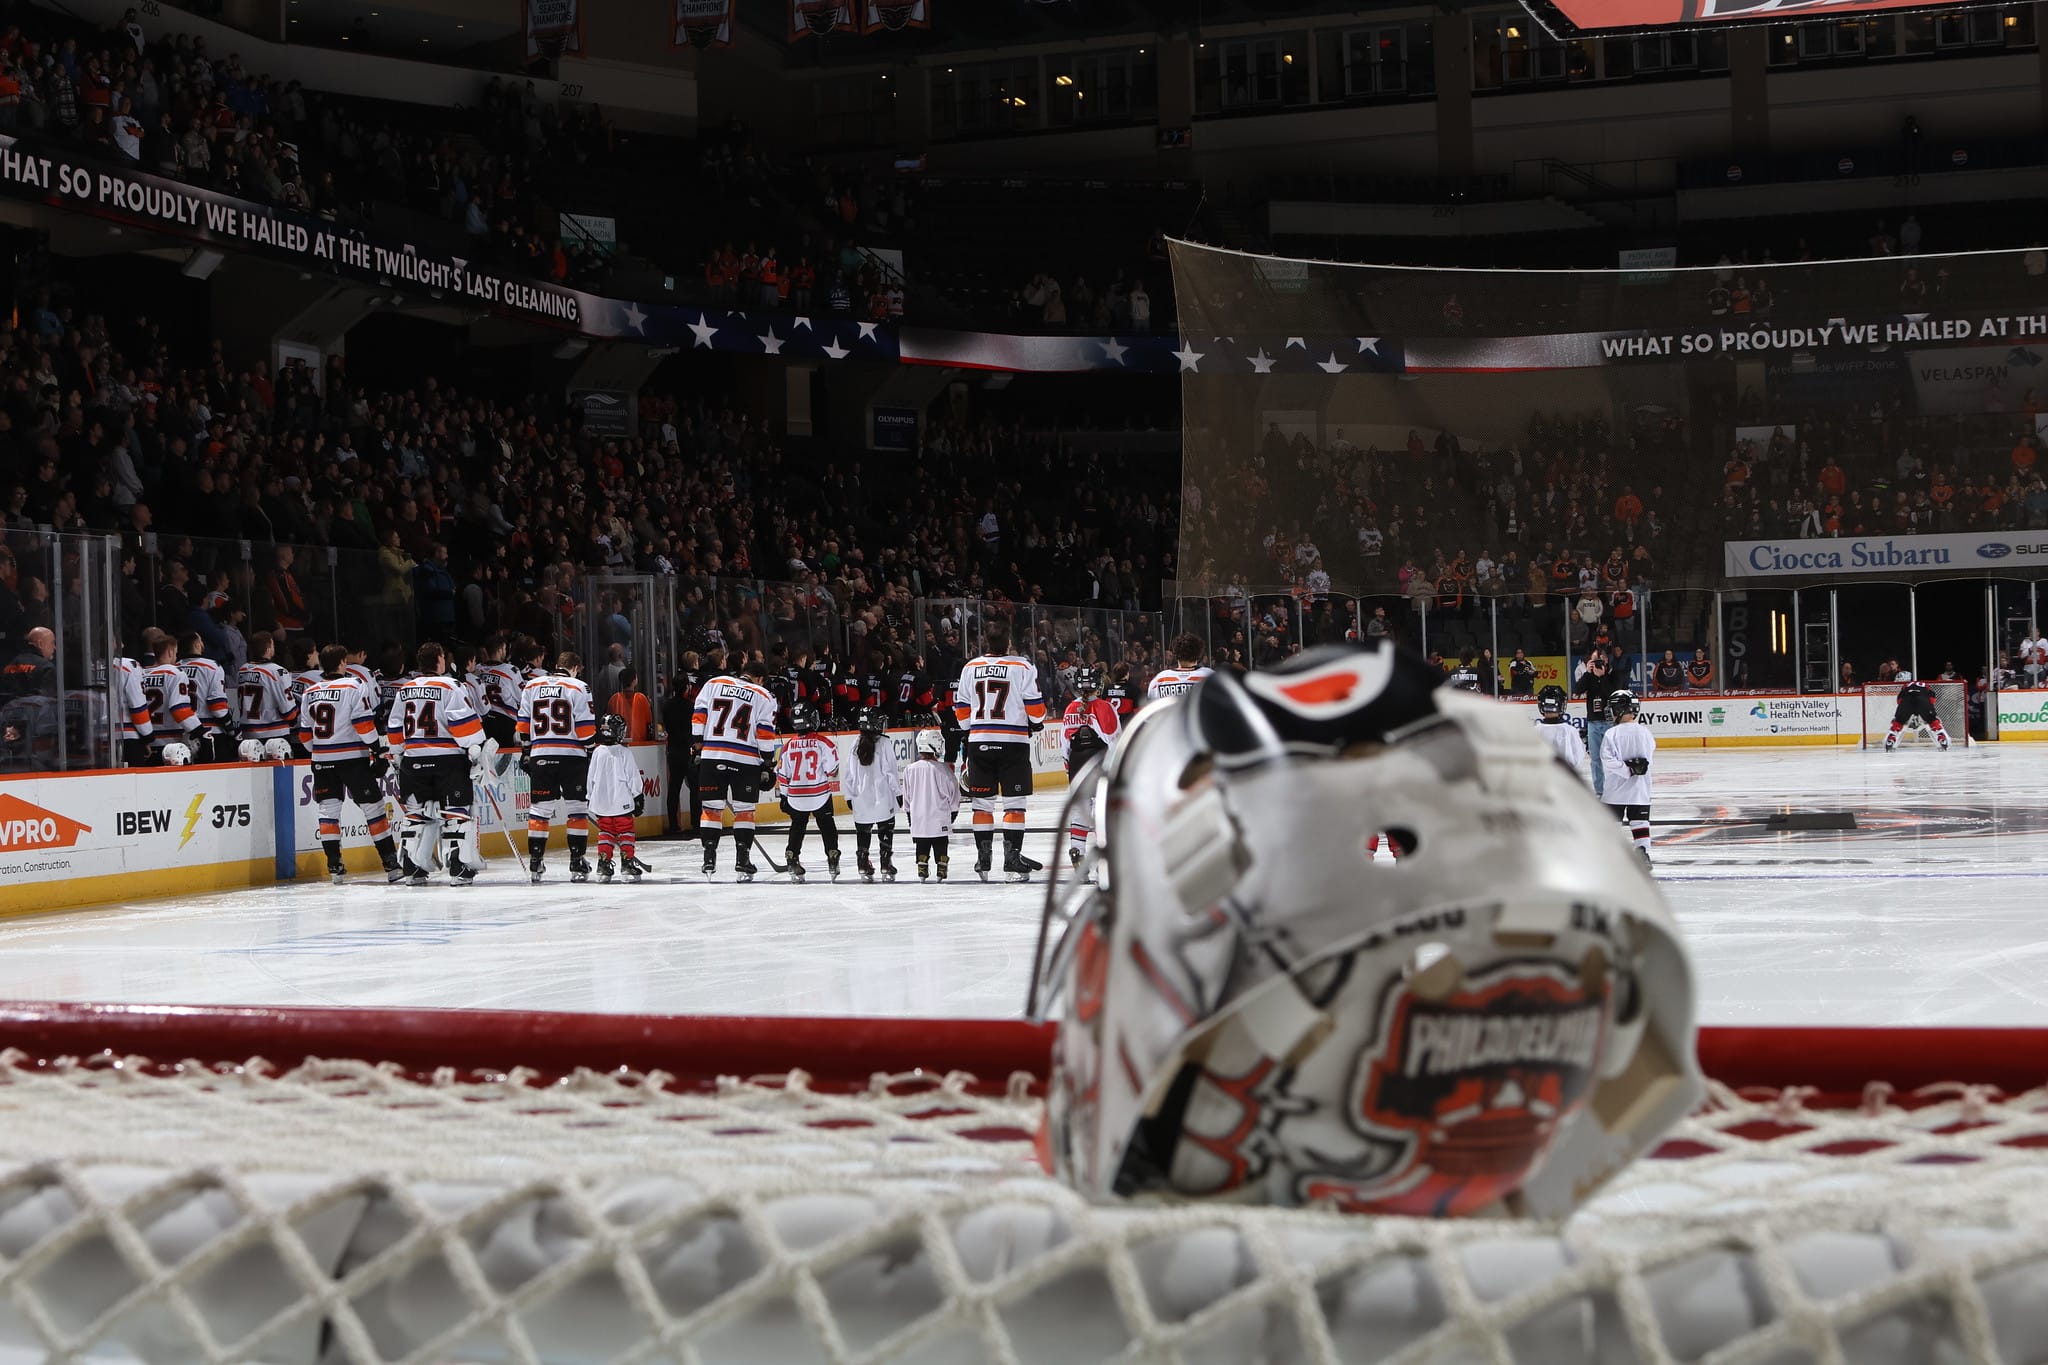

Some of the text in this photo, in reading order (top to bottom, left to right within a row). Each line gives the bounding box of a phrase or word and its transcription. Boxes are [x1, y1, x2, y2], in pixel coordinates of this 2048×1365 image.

[538, 3, 566, 14] SEASON
[682, 2, 723, 14] CHAMPIONS
[533, 11, 572, 26] CHAMPIONS
[561, 84, 583, 97] 207
[1894, 174, 1920, 188] 210
[1432, 206, 1455, 218] 209
[0, 149, 51, 189] HAT
[58, 163, 91, 199] SO
[99, 174, 200, 225] PROUDLY
[205, 202, 237, 236] WE
[243, 212, 308, 252] HAILED
[313, 231, 336, 260] AT
[340, 237, 370, 269] THE
[374, 247, 462, 292] TWILIGHT'S
[466, 271, 500, 302] LAST
[1601, 335, 1673, 358] WHAT
[1680, 333, 1714, 354] SO
[1721, 326, 1834, 351] PROUDLY
[1840, 324, 1879, 345] WE
[1886, 318, 1972, 343] HAILED
[1979, 316, 2009, 338] AT
[1921, 366, 2008, 383] VELASPAN
[878, 415, 914, 425] OLYMPUS
[1749, 541, 1951, 571] Ciocca Subaru
[975, 666, 1007, 679] WILSON
[401, 687, 441, 701] BJARNASON
[541, 687, 560, 697] BONK
[721, 686, 753, 702] WISDOM
[975, 681, 1011, 720] 17
[1770, 700, 1830, 712] Lehigh Valley
[404, 701, 438, 738] 64
[533, 699, 572, 736] 59
[713, 698, 753, 742] 74
[1657, 715, 1668, 723] TO
[1671, 711, 1703, 724] WIN!
[1770, 709, 1842, 719] Health Network
[1998, 712, 2048, 724] RODUC
[1780, 725, 1808, 733] Jefferson
[790, 740, 818, 749] WALLACE
[789, 750, 818, 781] 73
[116, 803, 250, 836] IBEW 375
[24, 859, 71, 873] Construction.
